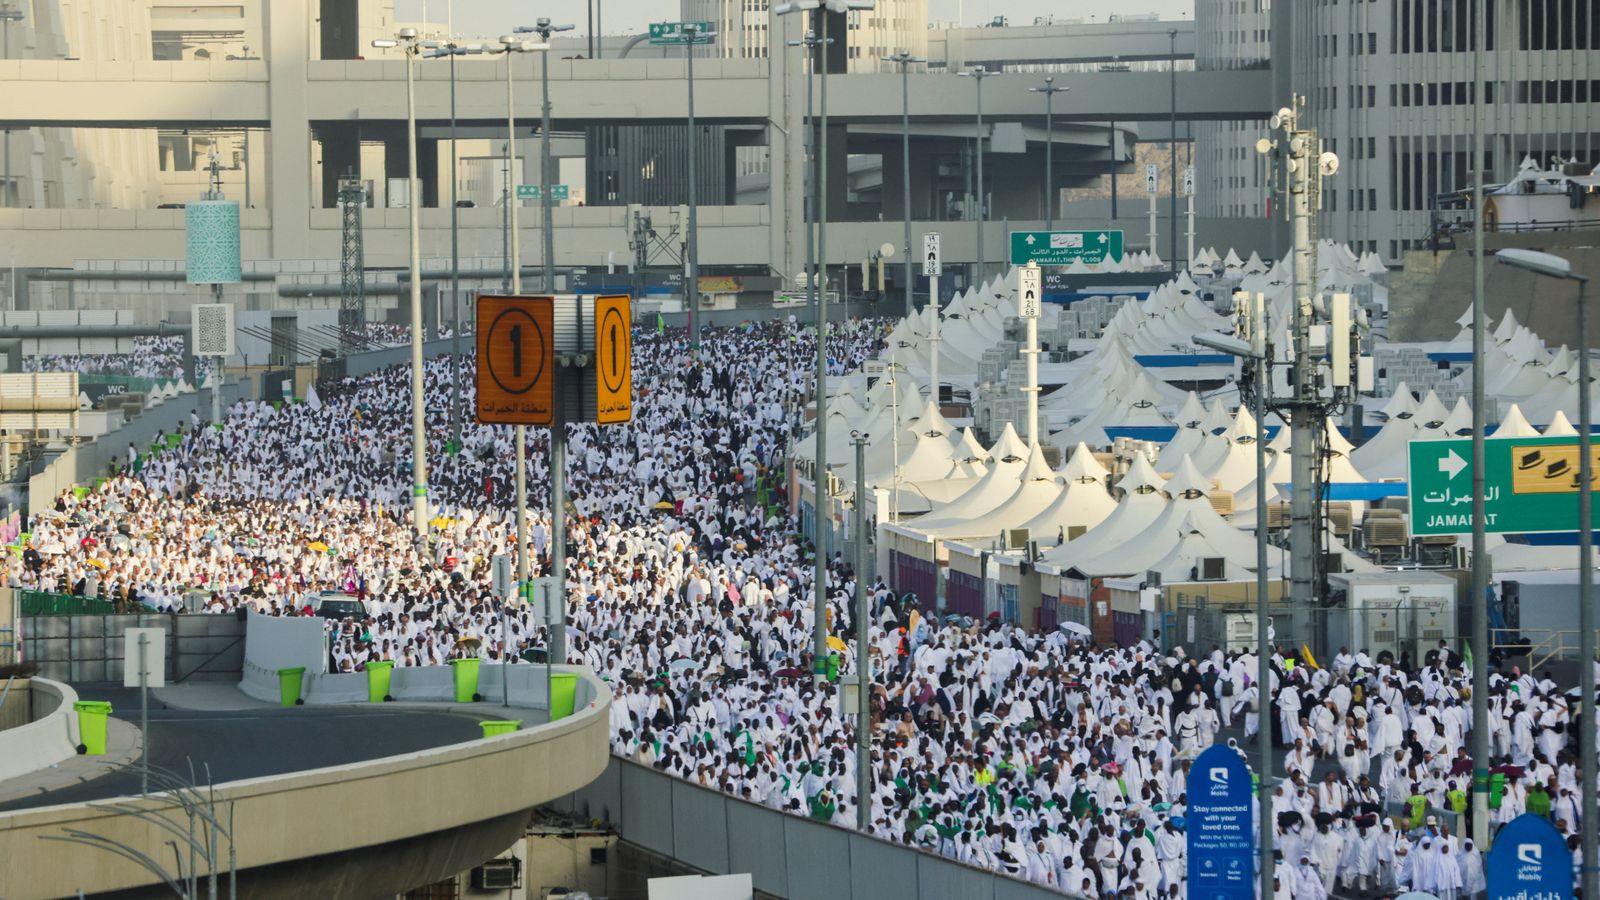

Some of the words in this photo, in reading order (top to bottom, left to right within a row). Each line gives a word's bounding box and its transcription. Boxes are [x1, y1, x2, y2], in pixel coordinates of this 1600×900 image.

[669, 273, 681, 281] WC
[1046, 275, 1061, 283] WC
[107, 385, 125, 394] WC
[1423, 486, 1499, 506] المرات
[1193, 805, 1209, 814] Stay
[1220, 815, 1237, 823] your
[1518, 873, 1542, 882] Mobily
